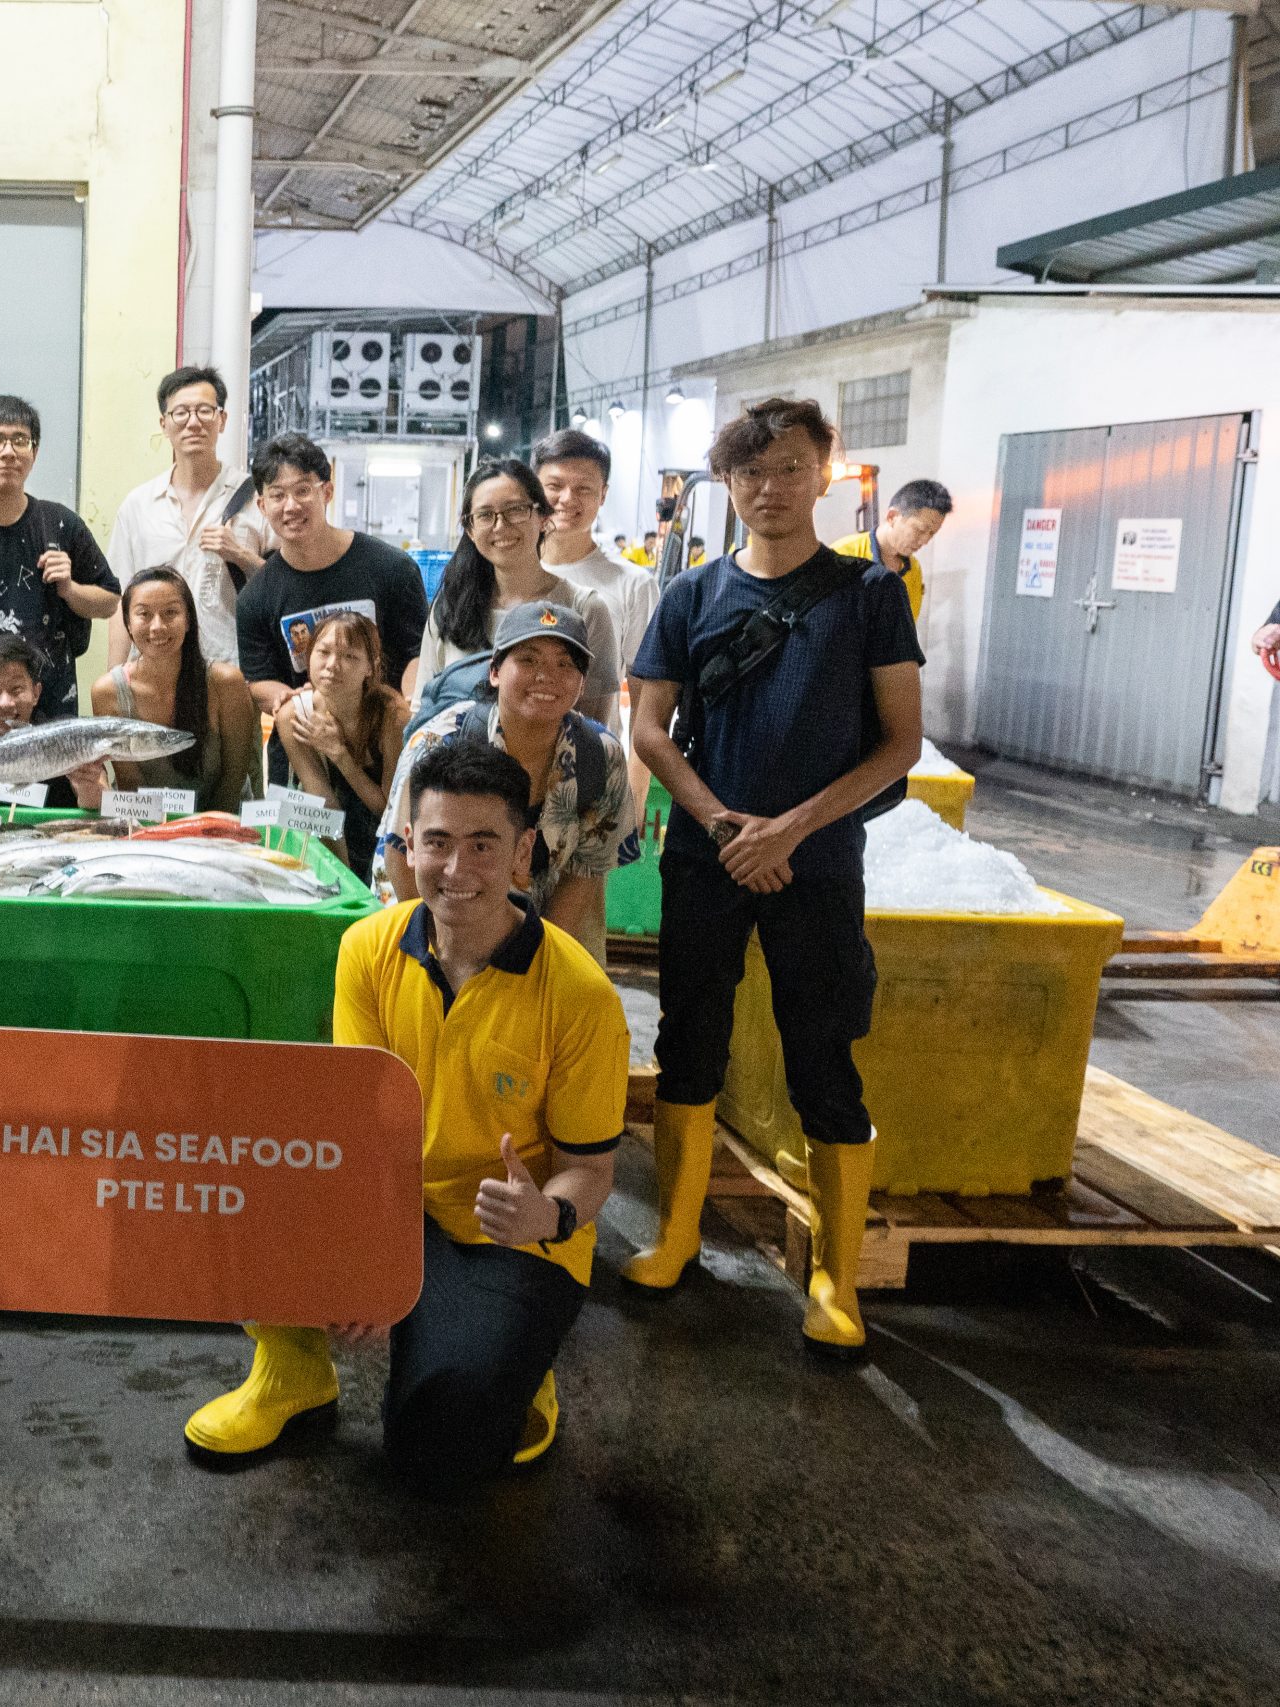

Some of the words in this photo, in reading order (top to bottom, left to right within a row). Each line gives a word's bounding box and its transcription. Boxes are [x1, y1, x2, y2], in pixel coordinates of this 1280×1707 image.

[1026, 519, 1057, 531] DANGER
[4, 786, 31, 798] SUID
[287, 791, 305, 801] RED
[113, 794, 132, 803] ANG
[135, 796, 152, 805] KAR
[255, 808, 280, 818] SMEL
[293, 805, 332, 820] YELLOW
[287, 819, 331, 834] CROAKER
[3, 1125, 70, 1157] HAI
[80, 1128, 144, 1161] SIA
[154, 1132, 343, 1170] SEAFOOD
[96, 1178, 164, 1211] PTE
[175, 1183, 245, 1215] LTD
